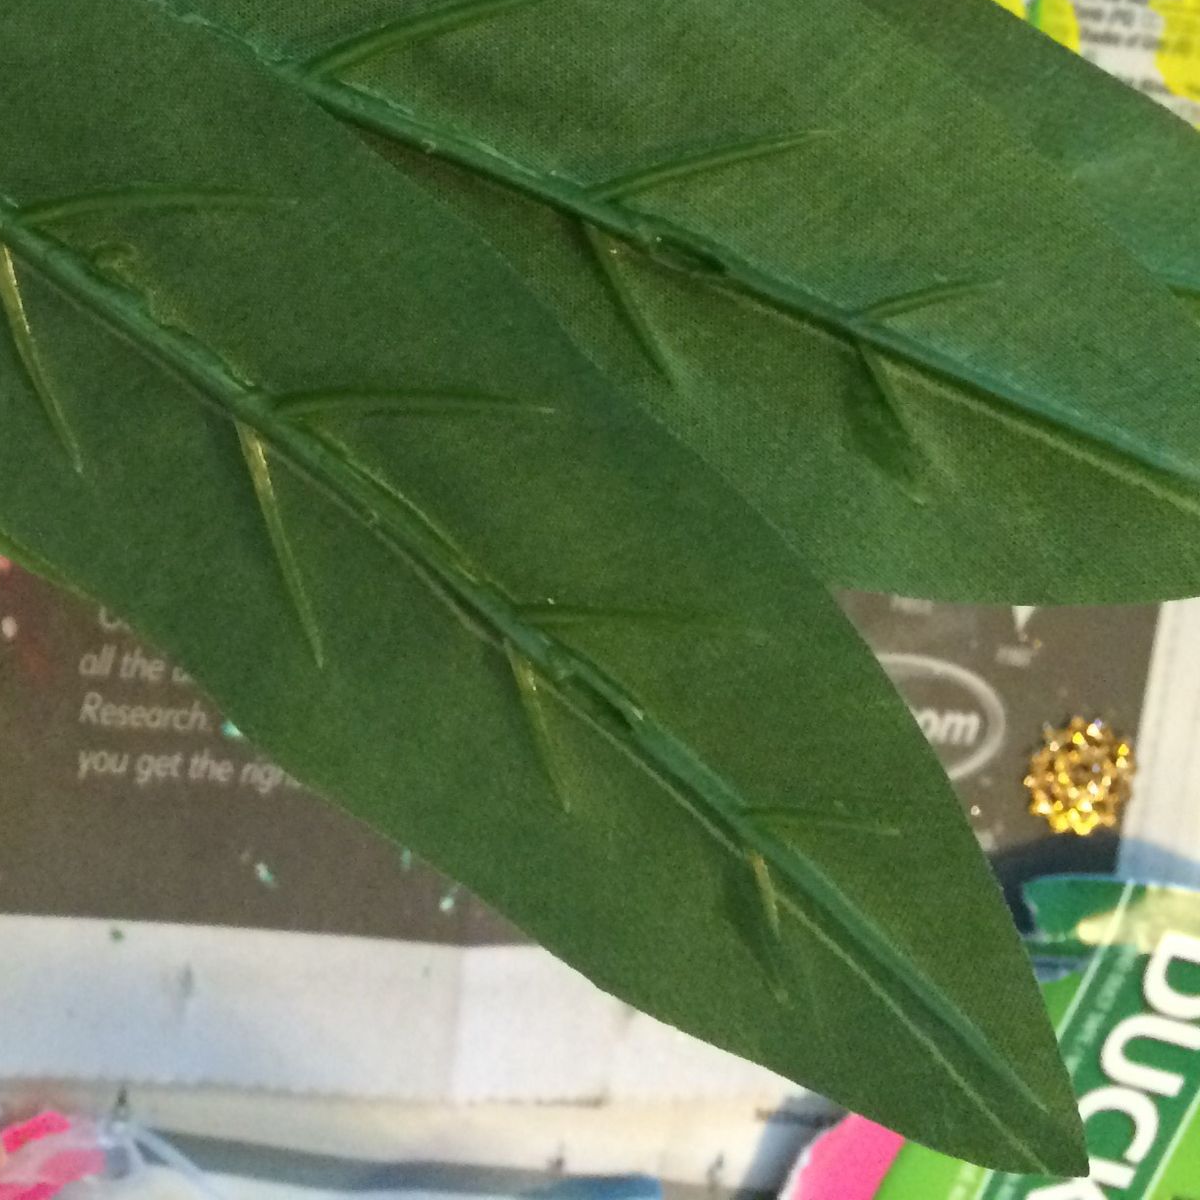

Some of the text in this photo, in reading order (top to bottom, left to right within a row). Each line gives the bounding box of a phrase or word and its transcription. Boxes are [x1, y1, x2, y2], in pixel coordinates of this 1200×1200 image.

[78, 691, 209, 731] Research
[77, 750, 130, 780] you
[134, 751, 184, 786] get
